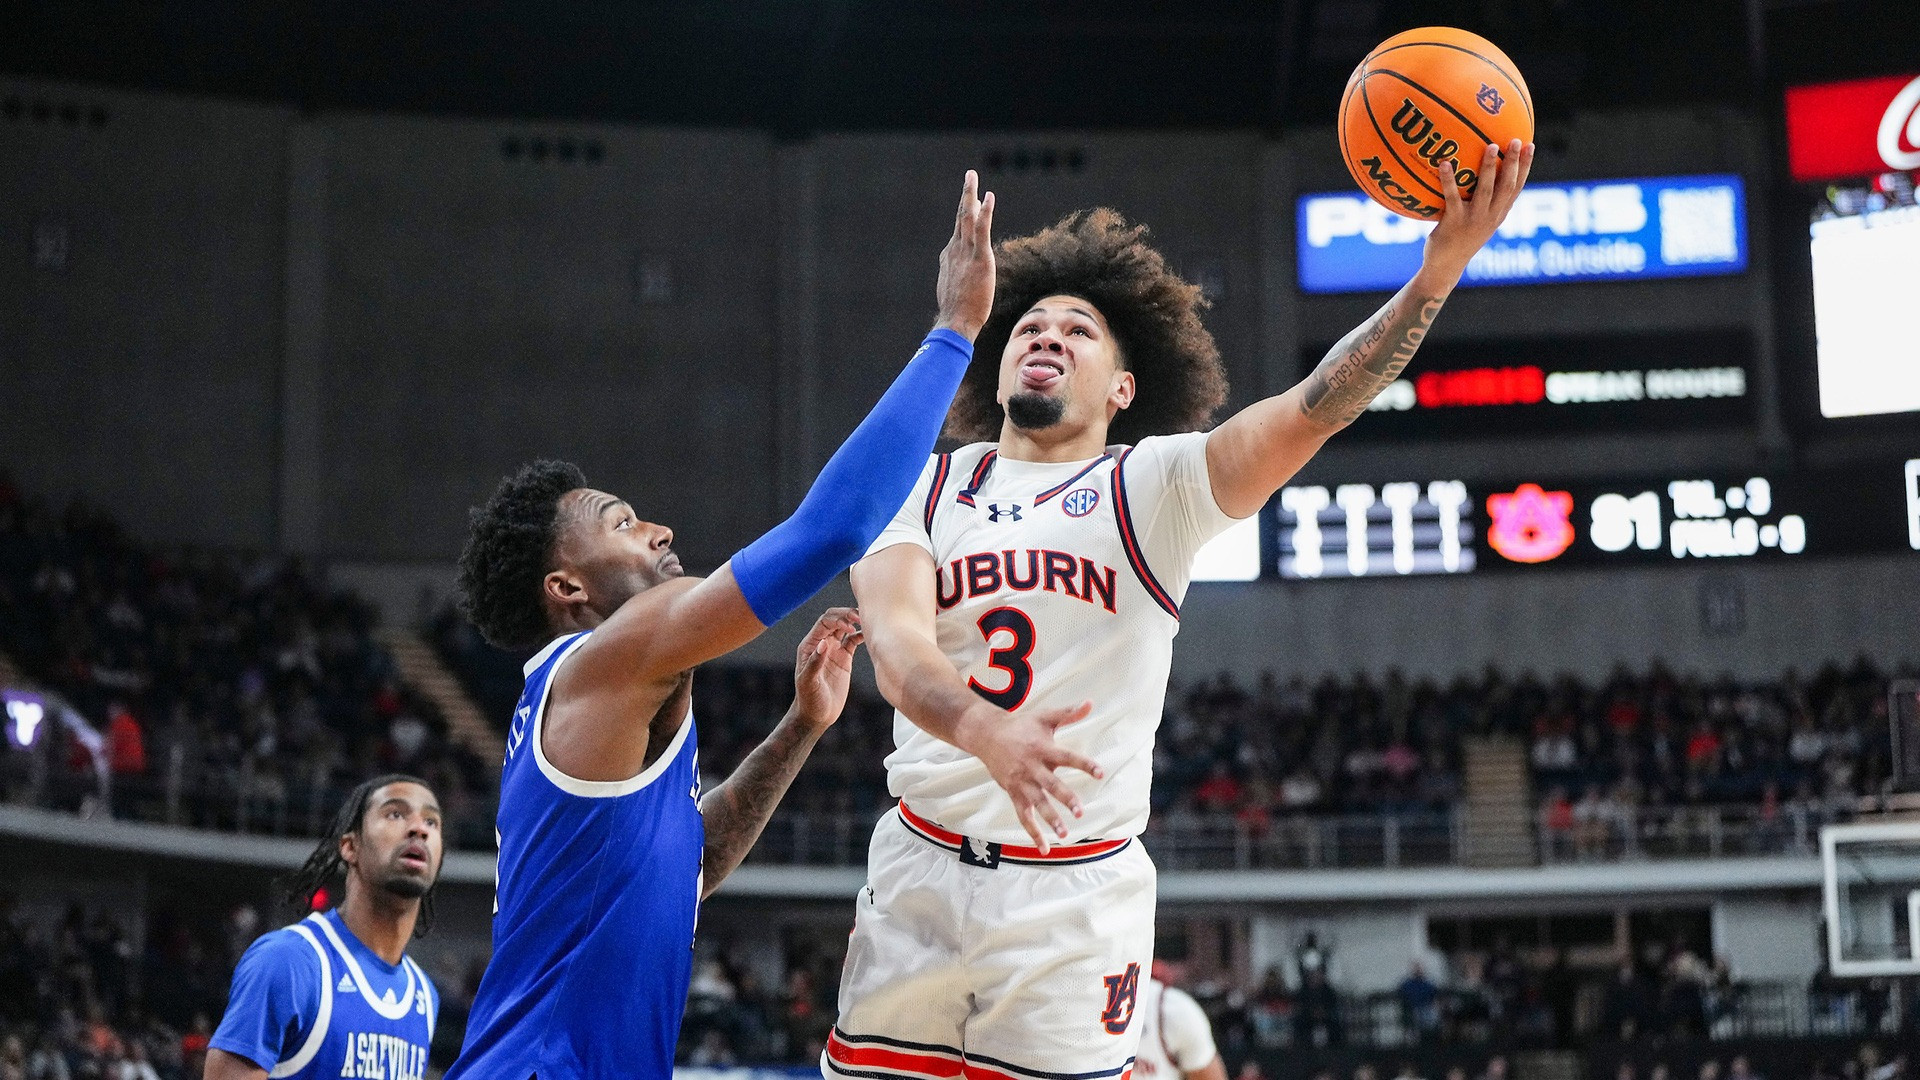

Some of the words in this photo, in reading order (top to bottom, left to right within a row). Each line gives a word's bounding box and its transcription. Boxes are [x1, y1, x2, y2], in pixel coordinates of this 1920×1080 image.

[1306, 183, 1648, 248] PORIS
[1361, 156, 1440, 218] NCAA
[1064, 489, 1097, 515] SEC
[936, 549, 1117, 615] UBURN
[967, 605, 1036, 713] 3
[340, 1031, 427, 1080] ASHEVILLE
